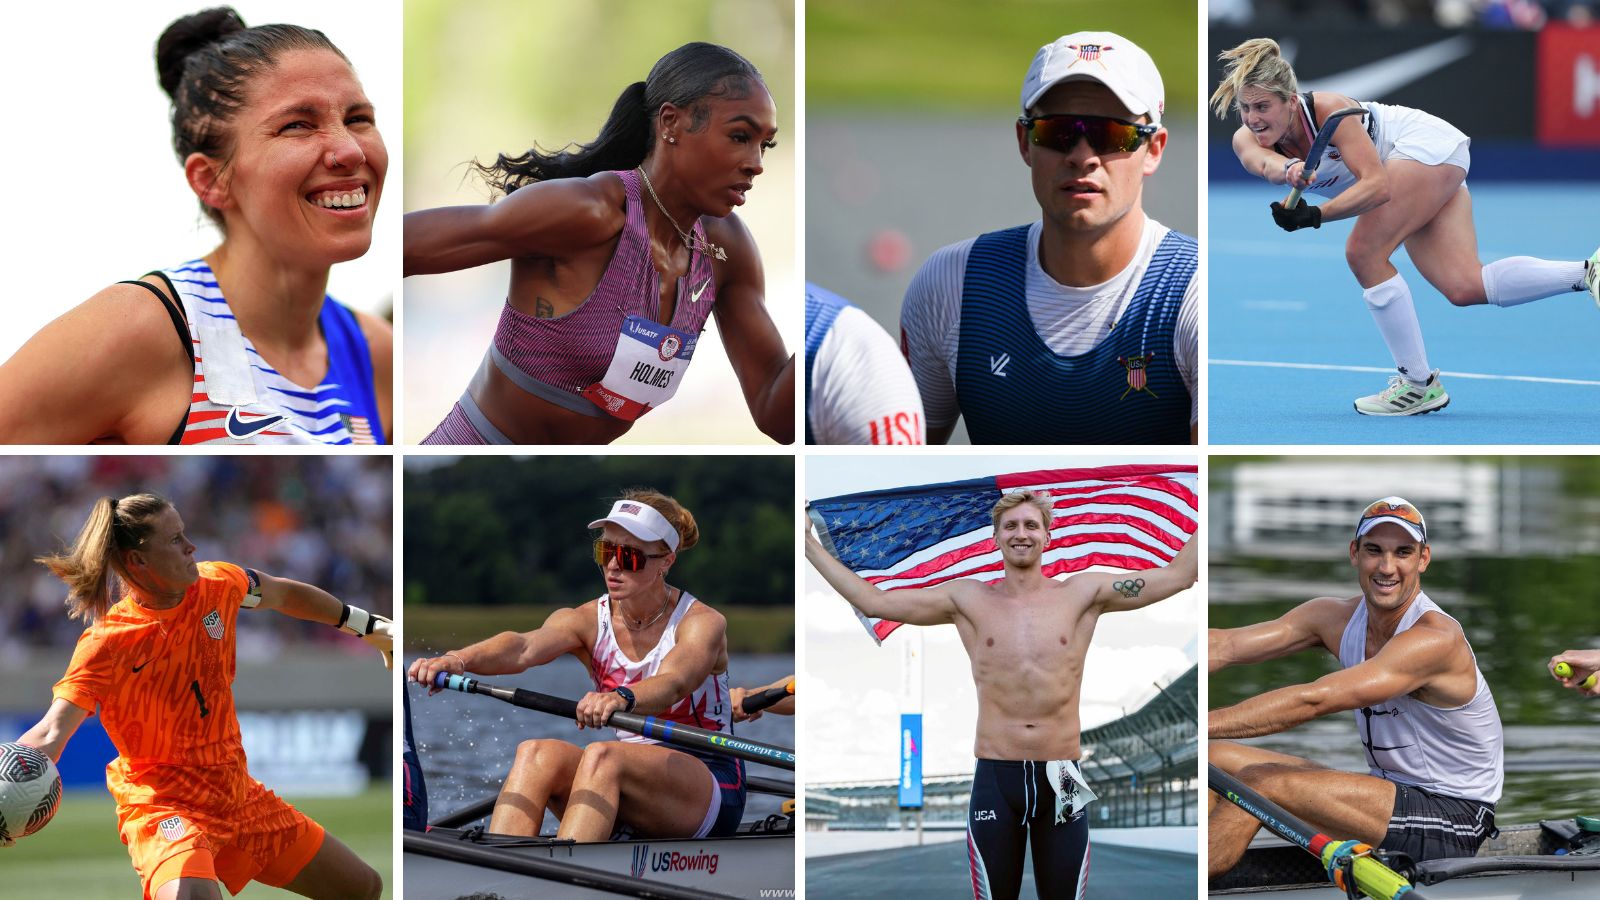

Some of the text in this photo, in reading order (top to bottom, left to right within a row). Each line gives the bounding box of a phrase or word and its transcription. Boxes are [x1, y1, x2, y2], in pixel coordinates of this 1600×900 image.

[638, 327, 659, 339] USATF
[629, 361, 674, 389] HOLMES
[204, 611, 219, 626] USA
[190, 680, 209, 719] 1
[727, 740, 774, 756] concept
[160, 817, 180, 829] USA
[974, 809, 997, 821] USA
[1238, 799, 1310, 848] concept 2 SKINNY
[652, 849, 719, 875] USRowing
